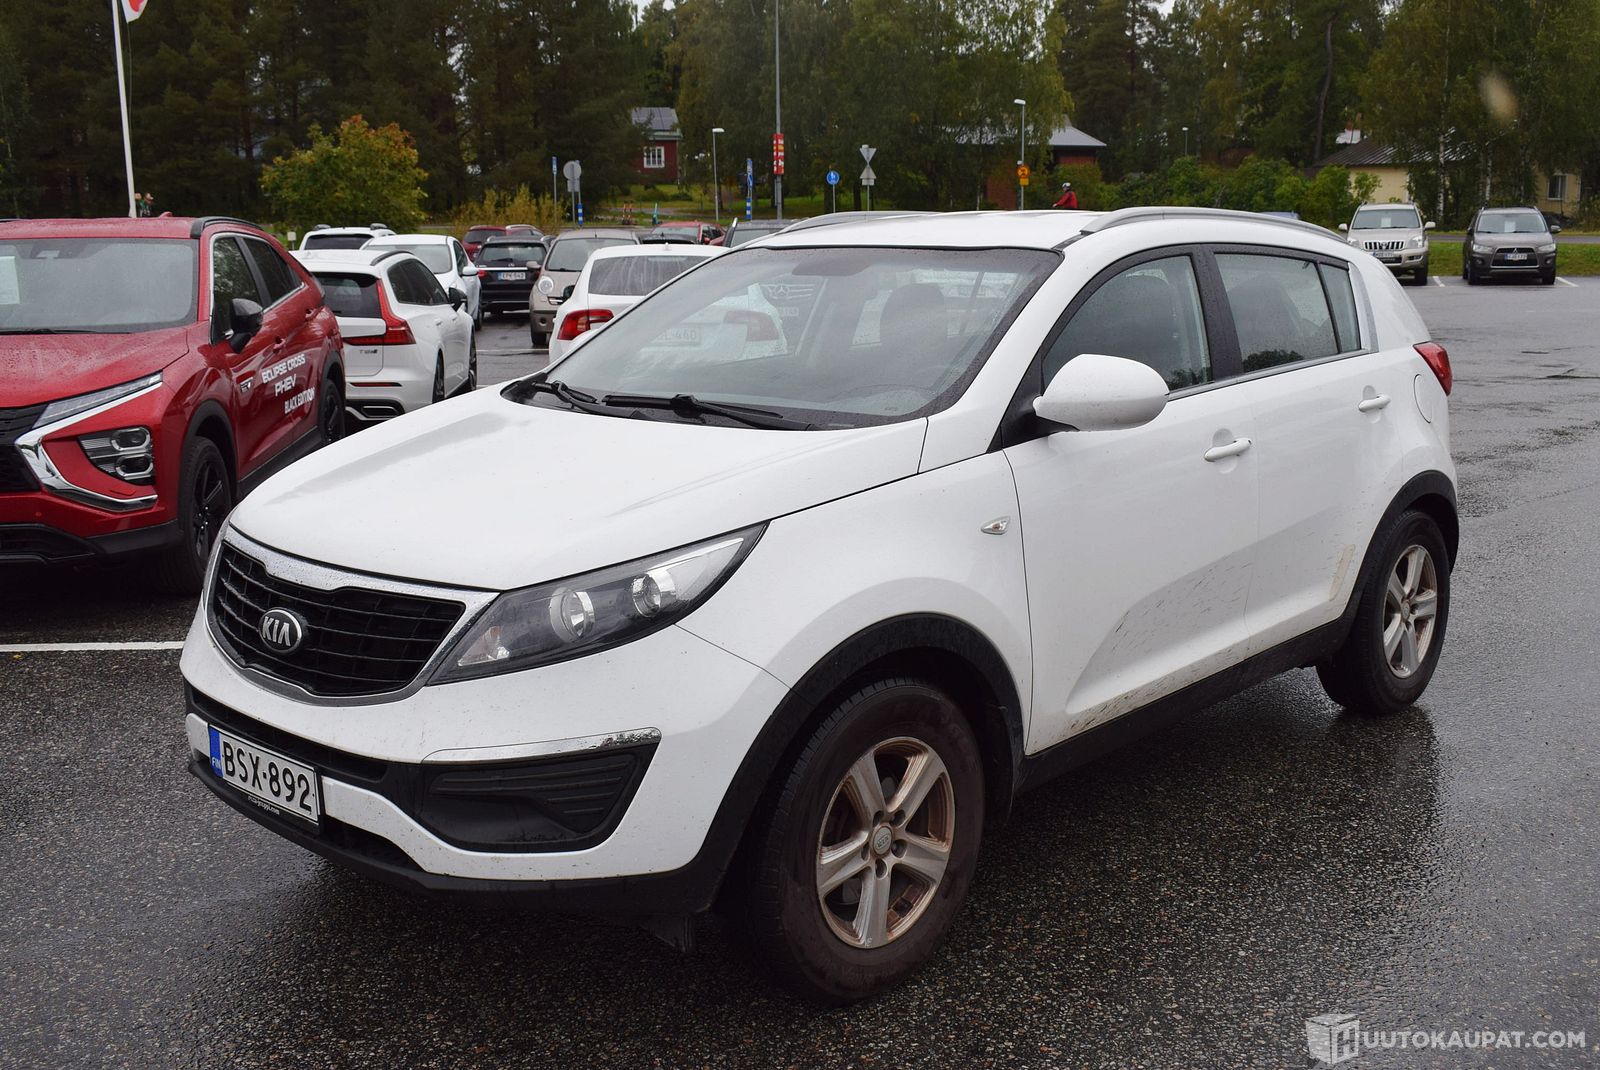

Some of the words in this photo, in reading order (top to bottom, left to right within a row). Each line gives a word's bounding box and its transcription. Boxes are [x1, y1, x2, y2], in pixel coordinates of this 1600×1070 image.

[261, 361, 288, 384] ECLIPSE
[287, 353, 306, 371] CROSS
[274, 373, 297, 397] PHEV
[284, 395, 299, 414] BLACK
[297, 386, 316, 407] EDITION
[262, 616, 291, 646] KIA
[211, 756, 222, 770] FIN
[223, 740, 312, 813] BSX-892
